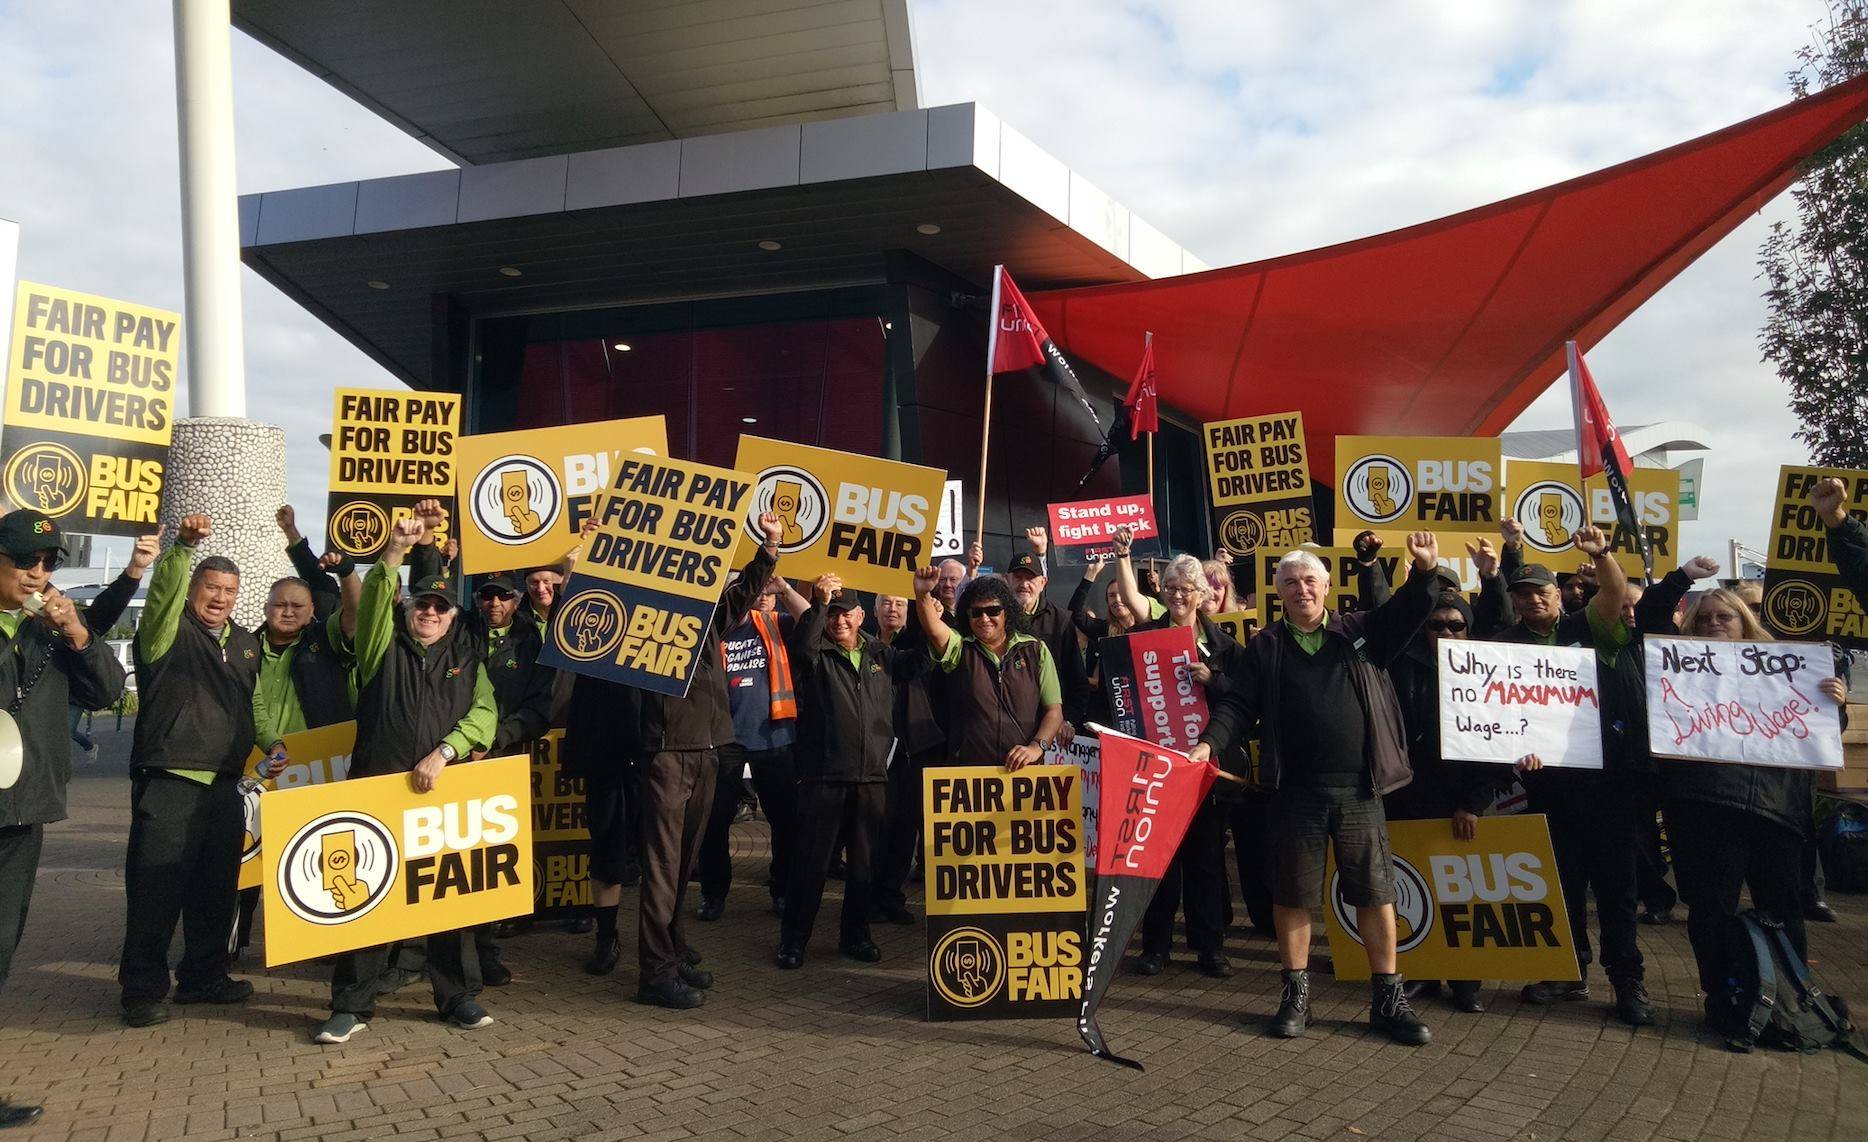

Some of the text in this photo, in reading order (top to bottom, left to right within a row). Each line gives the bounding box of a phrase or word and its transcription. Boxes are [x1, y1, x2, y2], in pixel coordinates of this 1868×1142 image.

[27, 294, 175, 352] FAIR PAY
[22, 335, 172, 391] FOR BUS
[19, 378, 167, 431] DRIVERS
[341, 395, 455, 425] FAIR PAY
[340, 426, 453, 456] FOR BUS
[1210, 418, 1298, 448] FAIR PAY
[90, 455, 163, 493] BUS
[338, 458, 450, 486] DRIVERS
[1213, 443, 1303, 473] FOR BUS
[1417, 460, 1493, 493] BUS
[615, 460, 751, 512] FAIR PAY
[1217, 468, 1305, 498] DRIVERS
[86, 486, 160, 523] FAIR
[602, 496, 664, 535] FOR
[669, 509, 736, 549] BUS
[834, 482, 929, 536] BUS
[1058, 503, 1145, 519] Stand up,
[1264, 507, 1312, 532] BUS
[1416, 492, 1493, 523] FAIR
[827, 523, 924, 572] FAIR
[1059, 524, 1101, 539] fight
[1266, 527, 1313, 547] FAIR
[587, 532, 721, 588] DRIVERS
[625, 604, 702, 649] BUS
[615, 637, 692, 680] FAIR
[1448, 648, 1577, 687] Why is there
[1661, 644, 1807, 683] Next Stop:
[1171, 650, 1197, 707] Toot
[1452, 681, 1598, 709] no MAXIMUM
[1660, 677, 1694, 708] A
[1143, 650, 1176, 747] support
[932, 777, 1004, 813] FAIR
[1013, 776, 1074, 810] PAY
[403, 794, 518, 859] BUS
[934, 821, 996, 856] FOR
[1011, 820, 1076, 854] BUS
[405, 843, 521, 906] FAIR
[935, 862, 1076, 900] DRIVERS
[1430, 853, 1548, 903] BUS
[1440, 903, 1561, 948] FAIR
[1007, 931, 1081, 968] BUS
[1007, 966, 1083, 1001] FAIR
